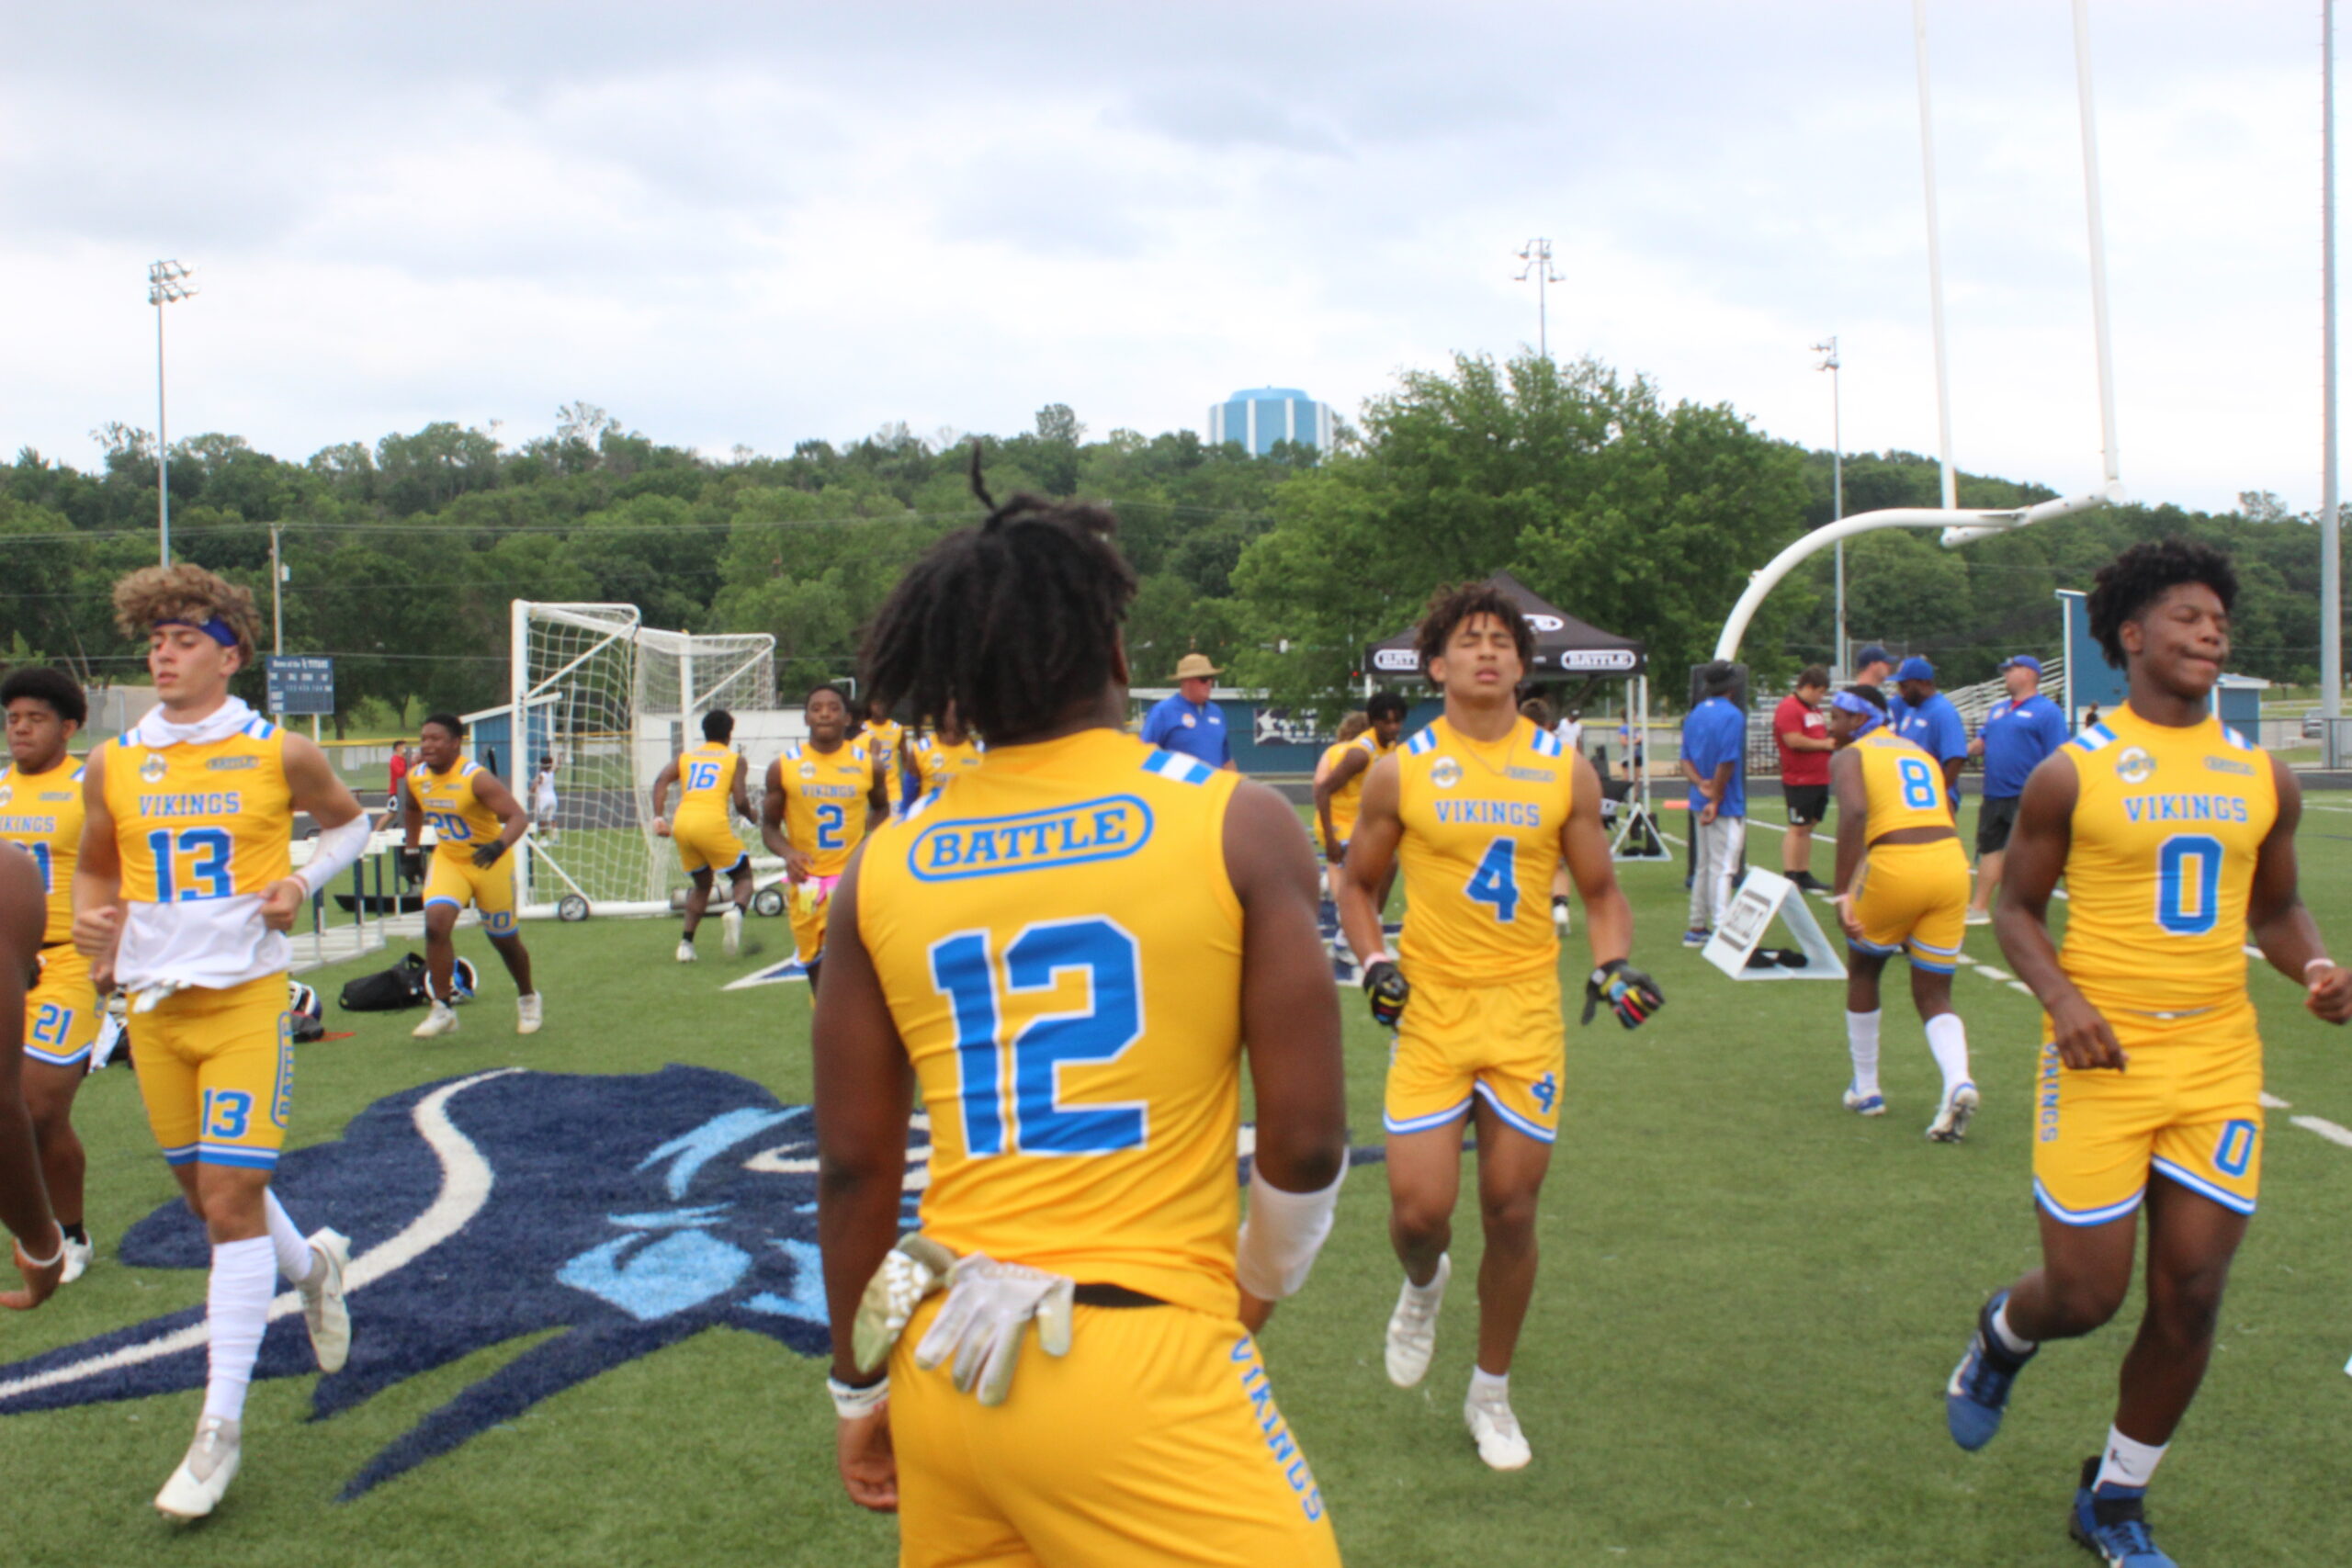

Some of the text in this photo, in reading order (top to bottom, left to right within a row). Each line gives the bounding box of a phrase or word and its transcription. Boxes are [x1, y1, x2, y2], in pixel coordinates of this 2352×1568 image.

[686, 761, 719, 791] 16
[801, 785, 855, 797] VIKINGS
[1897, 757, 1938, 809] 8
[139, 792, 241, 817] VIKINGS
[425, 812, 472, 840] 20
[815, 803, 845, 851] 2
[1434, 801, 1541, 828] VIKINGS
[2122, 795, 2248, 823] VIKINGS
[930, 808, 1126, 868] BATTLE
[147, 826, 234, 903] 13
[1463, 835, 1520, 924] 4
[2154, 832, 2225, 936] 0
[32, 1002, 74, 1046] 21
[927, 915, 1149, 1159] 12
[201, 1087, 254, 1140] 13
[1529, 1072, 1556, 1114] 4
[2211, 1118, 2257, 1178] 0
[1230, 1335, 1326, 1523] VIKINGS
